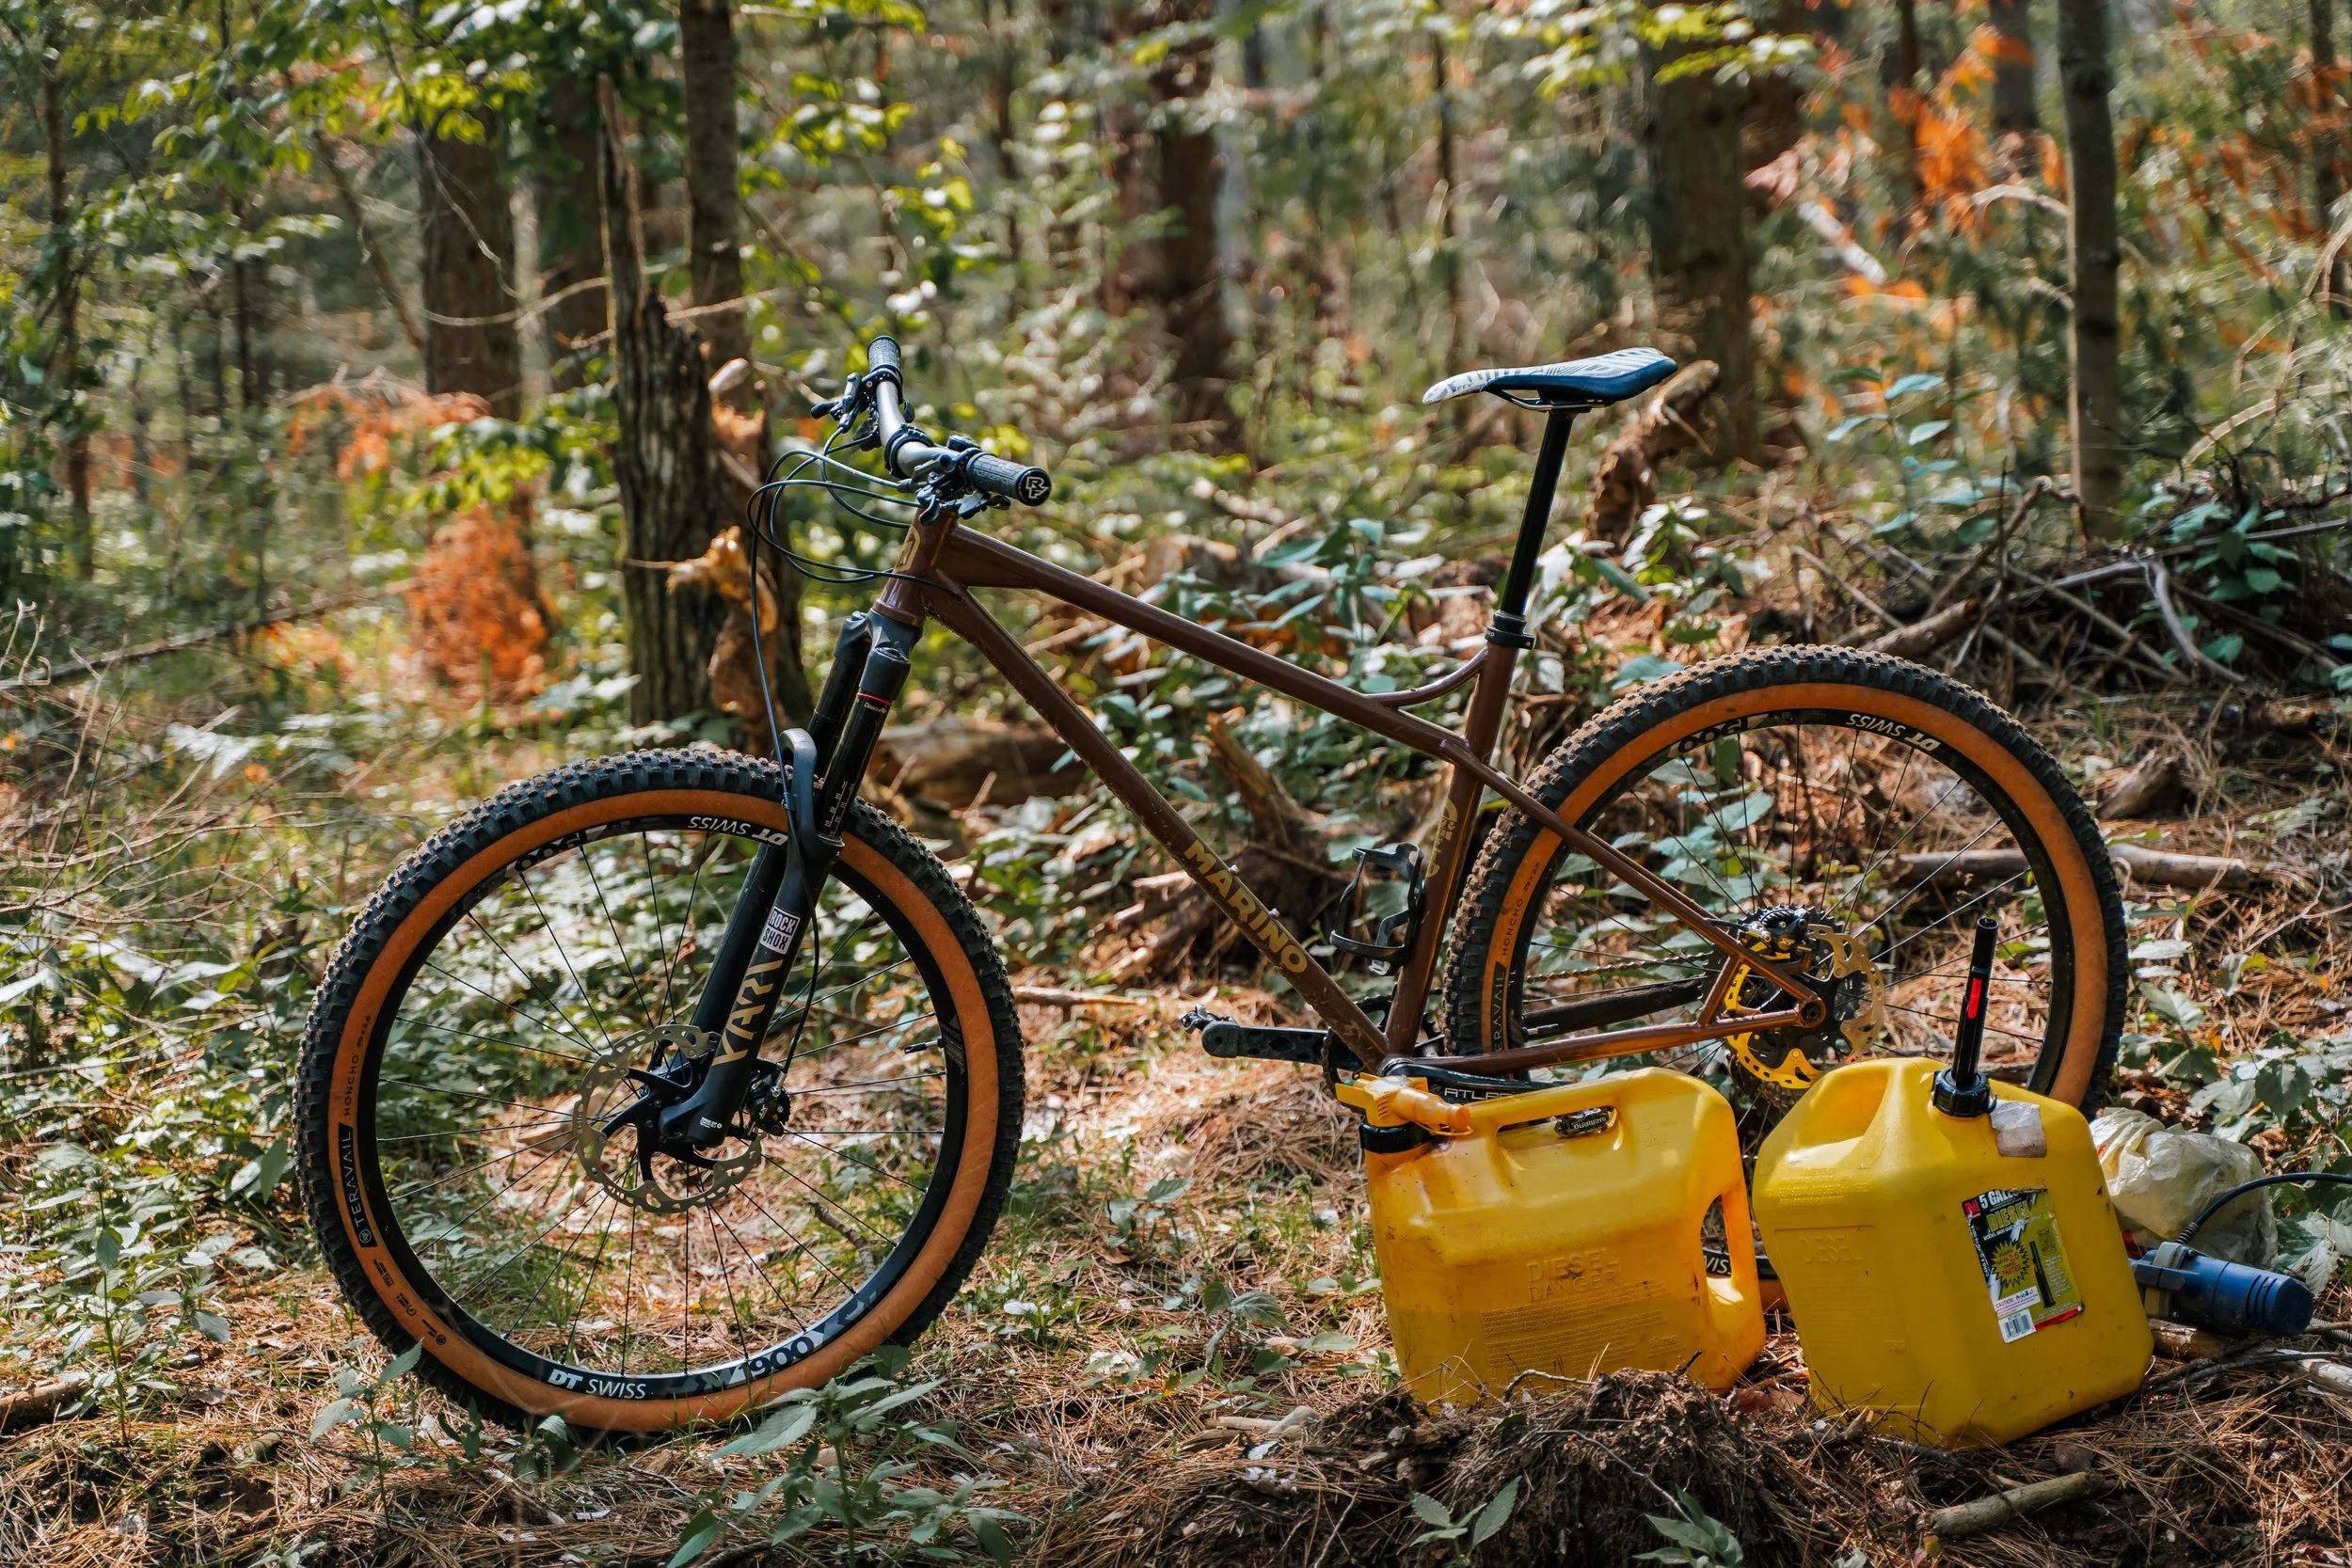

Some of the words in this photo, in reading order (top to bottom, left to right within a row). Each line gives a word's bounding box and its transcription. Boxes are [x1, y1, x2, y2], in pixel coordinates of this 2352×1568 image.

[1846, 713, 1906, 737] SWISS
[1904, 730, 1942, 752] DT
[688, 816, 751, 835] SWISS
[752, 828, 788, 846] DT
[1184, 839, 1308, 973] MARINO
[769, 910, 797, 935] ROCK
[1502, 898, 1523, 956] HONCHO
[763, 928, 788, 951] SHOX
[713, 958, 783, 1067] YARI
[1494, 971, 1505, 1052] ERAVAIL
[343, 1054, 359, 1116] HONCHO
[342, 1131, 365, 1227] TERAVAIL
[1979, 1194, 1989, 1210] 5
[1986, 1200, 2031, 1232] DIESEL
[1799, 1235, 1863, 1263] DIESEL
[1526, 1249, 1619, 1283] DIESEL
[2002, 1264, 2021, 1276] FASTER
[1528, 1271, 1624, 1302] DANGER
[548, 1369, 583, 1389] DT
[586, 1379, 646, 1400] SWISS
